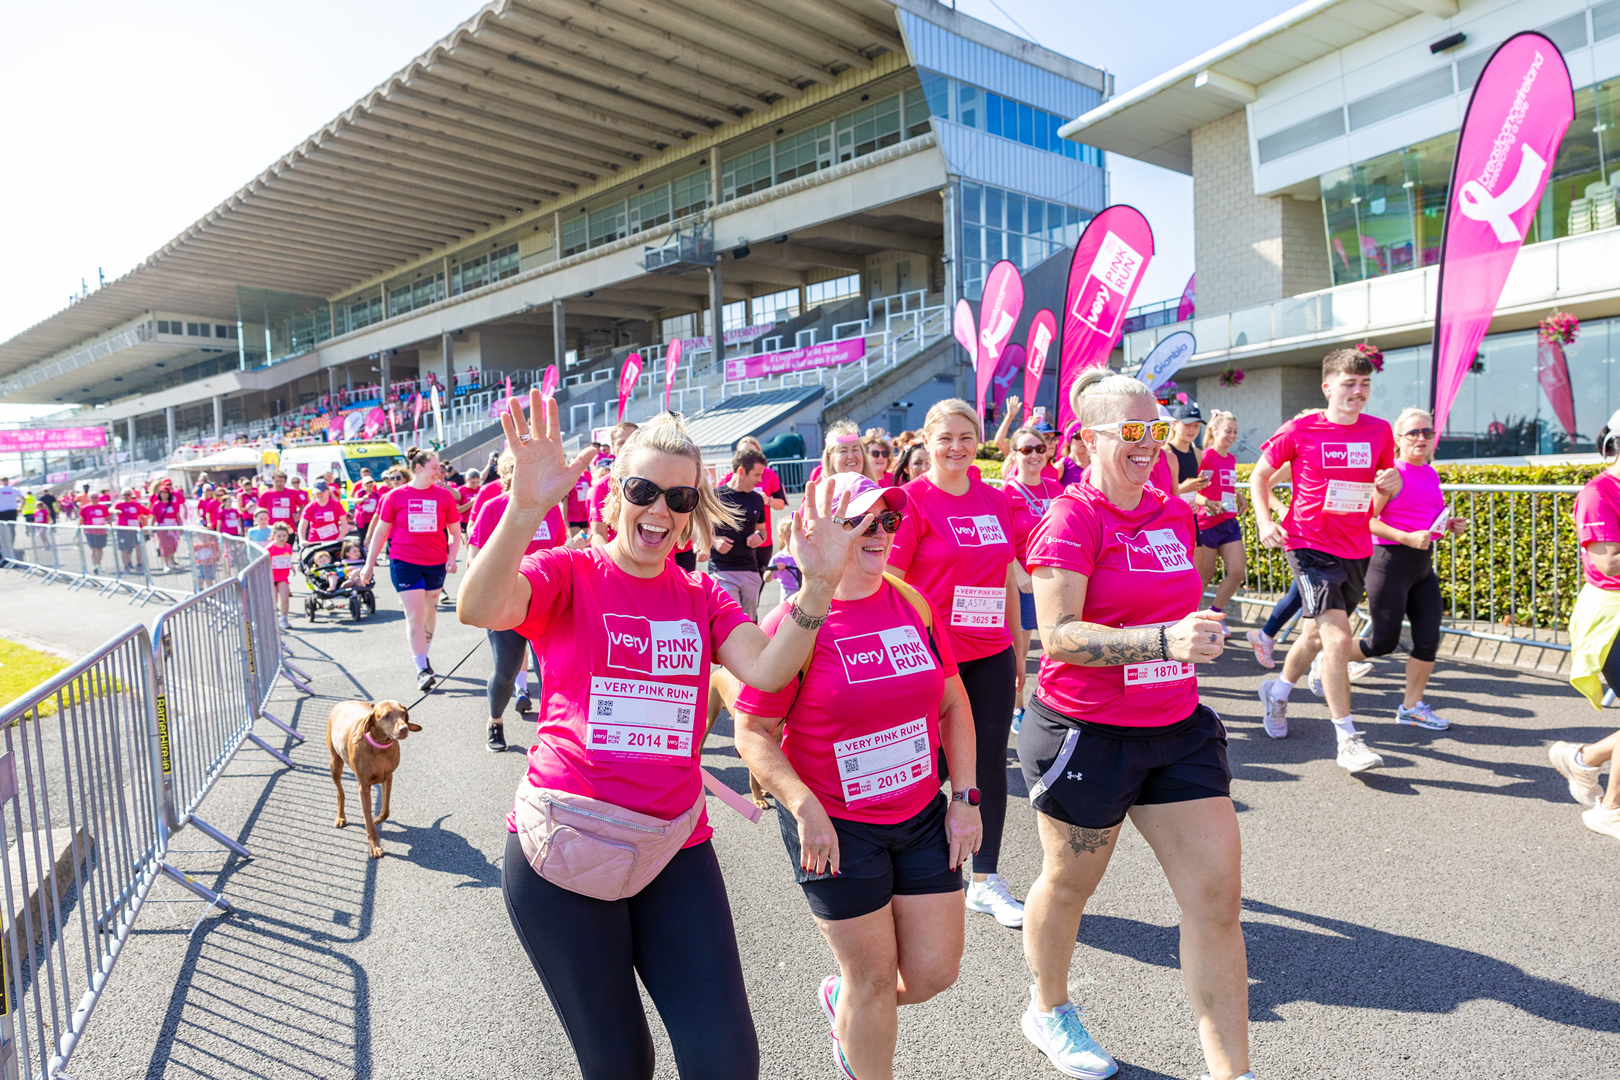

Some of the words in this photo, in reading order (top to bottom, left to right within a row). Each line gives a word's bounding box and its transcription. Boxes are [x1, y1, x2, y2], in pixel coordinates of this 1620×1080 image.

[1105, 246, 1127, 282] PINK
[1115, 257, 1135, 289] RUN
[1087, 284, 1110, 323] very
[1153, 343, 1188, 374] Glanbia
[1325, 451, 1347, 460] very
[979, 525, 1001, 533] PINK
[983, 533, 1002, 541] RUN
[1154, 542, 1185, 556] PINK
[1161, 553, 1186, 567] RUN
[971, 615, 989, 624] 3625
[610, 631, 649, 654] very
[656, 638, 698, 652] PINK
[890, 641, 925, 658] PINK
[657, 654, 693, 669] RUN
[845, 648, 884, 665] very
[895, 653, 929, 670] RUN
[1154, 664, 1178, 678] 1870
[604, 681, 635, 693] VERY
[638, 684, 664, 697] PINK
[667, 688, 689, 700] RUN
[157, 698, 171, 771] BarrierHire.ie
[627, 732, 661, 748] 2014
[845, 738, 872, 751] VERY
[874, 731, 898, 745] PINK
[900, 723, 920, 737] RUN
[877, 771, 907, 789] 2013
